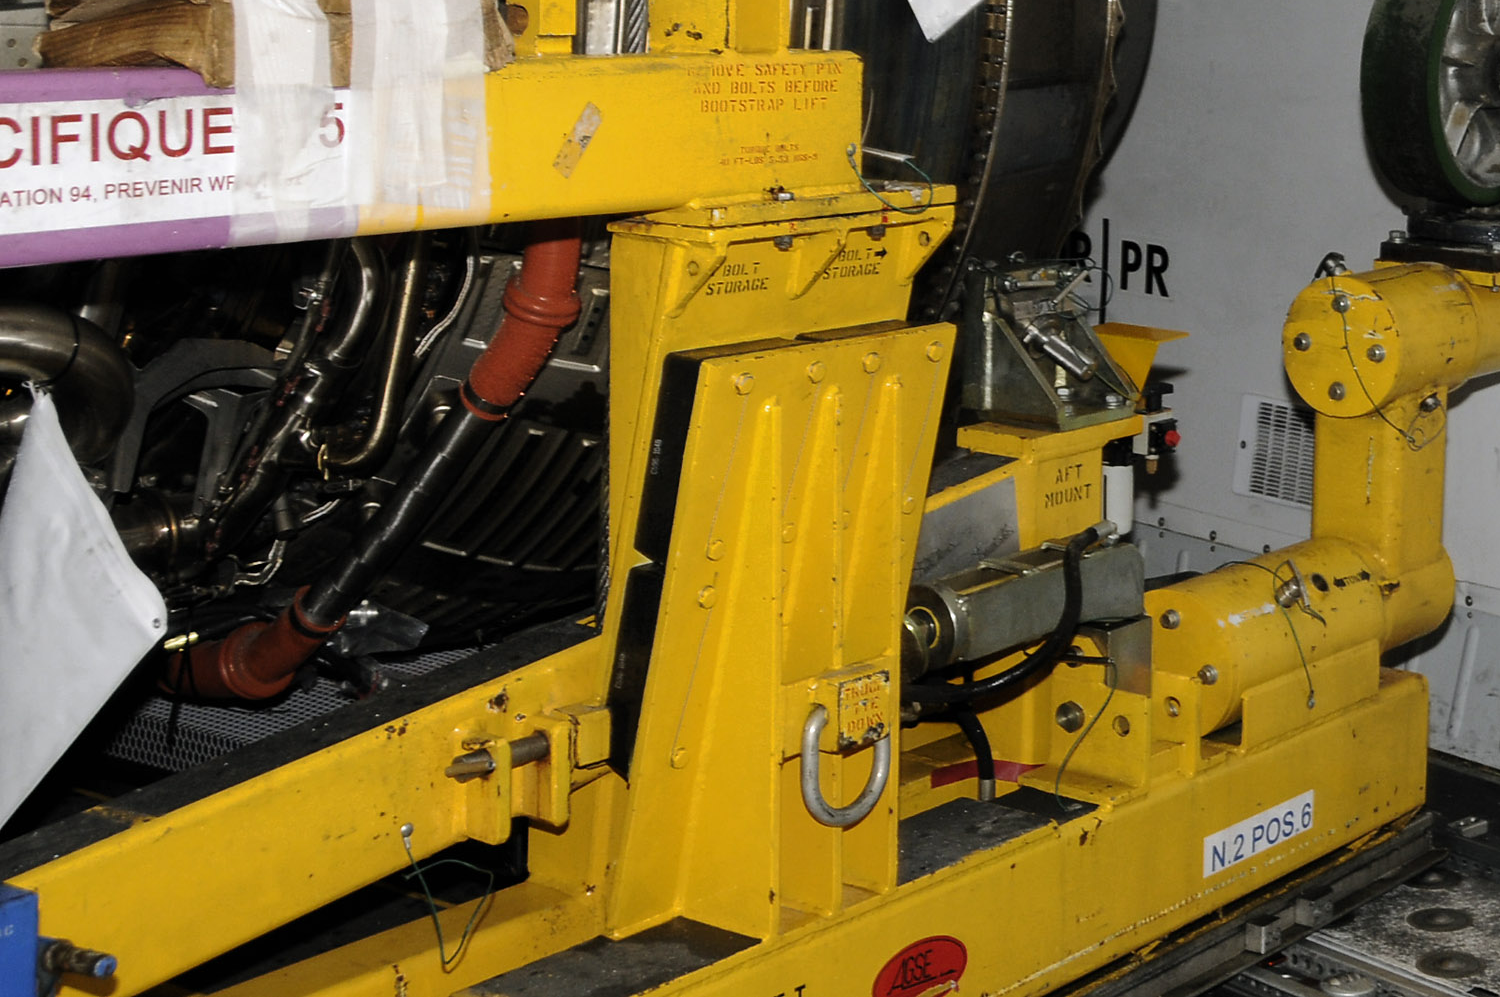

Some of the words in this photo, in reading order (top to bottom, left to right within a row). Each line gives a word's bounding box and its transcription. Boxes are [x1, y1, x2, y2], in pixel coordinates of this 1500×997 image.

[755, 63, 807, 77] SAFETY
[816, 62, 843, 76] PIN
[694, 81, 721, 95] AND
[730, 81, 776, 95] BOLTS
[785, 79, 838, 93] BEFORE
[701, 98, 785, 113] BOOTSTRAP
[794, 97, 828, 111] LIFT
[0, 106, 235, 169] CIFIQUE
[70, 185, 98, 204] 94,
[105, 177, 205, 202] PREVENIR
[838, 247, 873, 262] BOLT
[722, 261, 761, 278] BOLT
[822, 262, 881, 280] STORAGE
[1120, 239, 1170, 298] PR
[706, 277, 769, 296] STORAGE
[1055, 463, 1083, 484] AFT
[1044, 483, 1092, 509] MOUNT
[1211, 833, 1245, 872] N.2
[1251, 802, 1312, 854] POS.6
